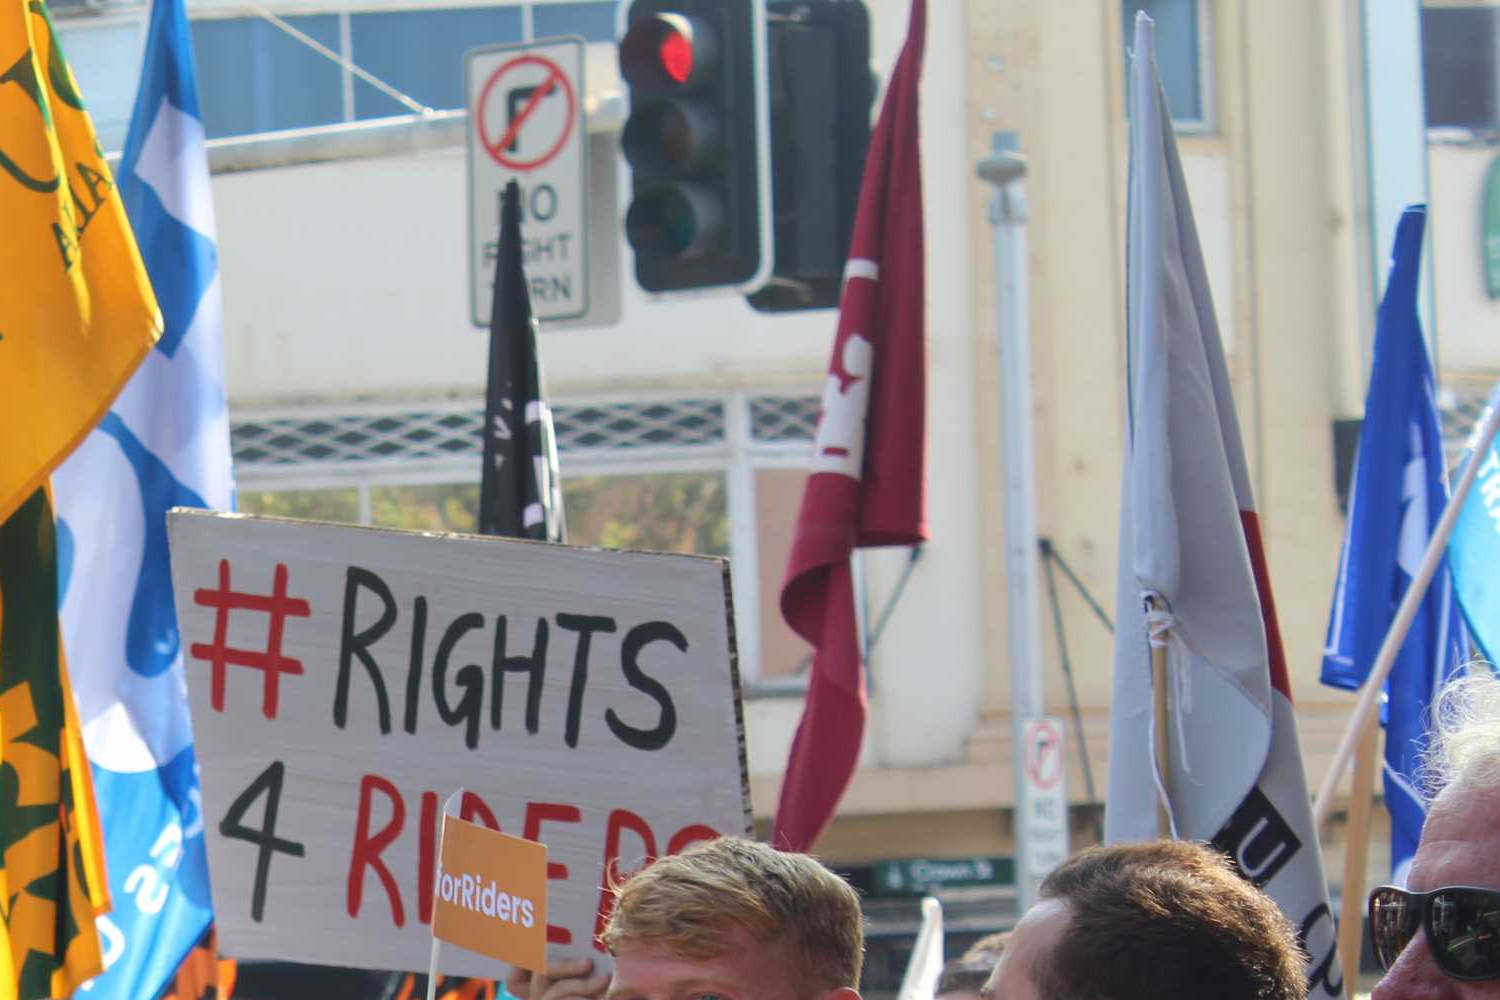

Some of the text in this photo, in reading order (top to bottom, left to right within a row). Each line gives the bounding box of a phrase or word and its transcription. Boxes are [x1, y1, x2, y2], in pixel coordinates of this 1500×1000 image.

[483, 233, 573, 270] RGHT
[219, 760, 306, 924] 4
[346, 773, 722, 952] RIER
